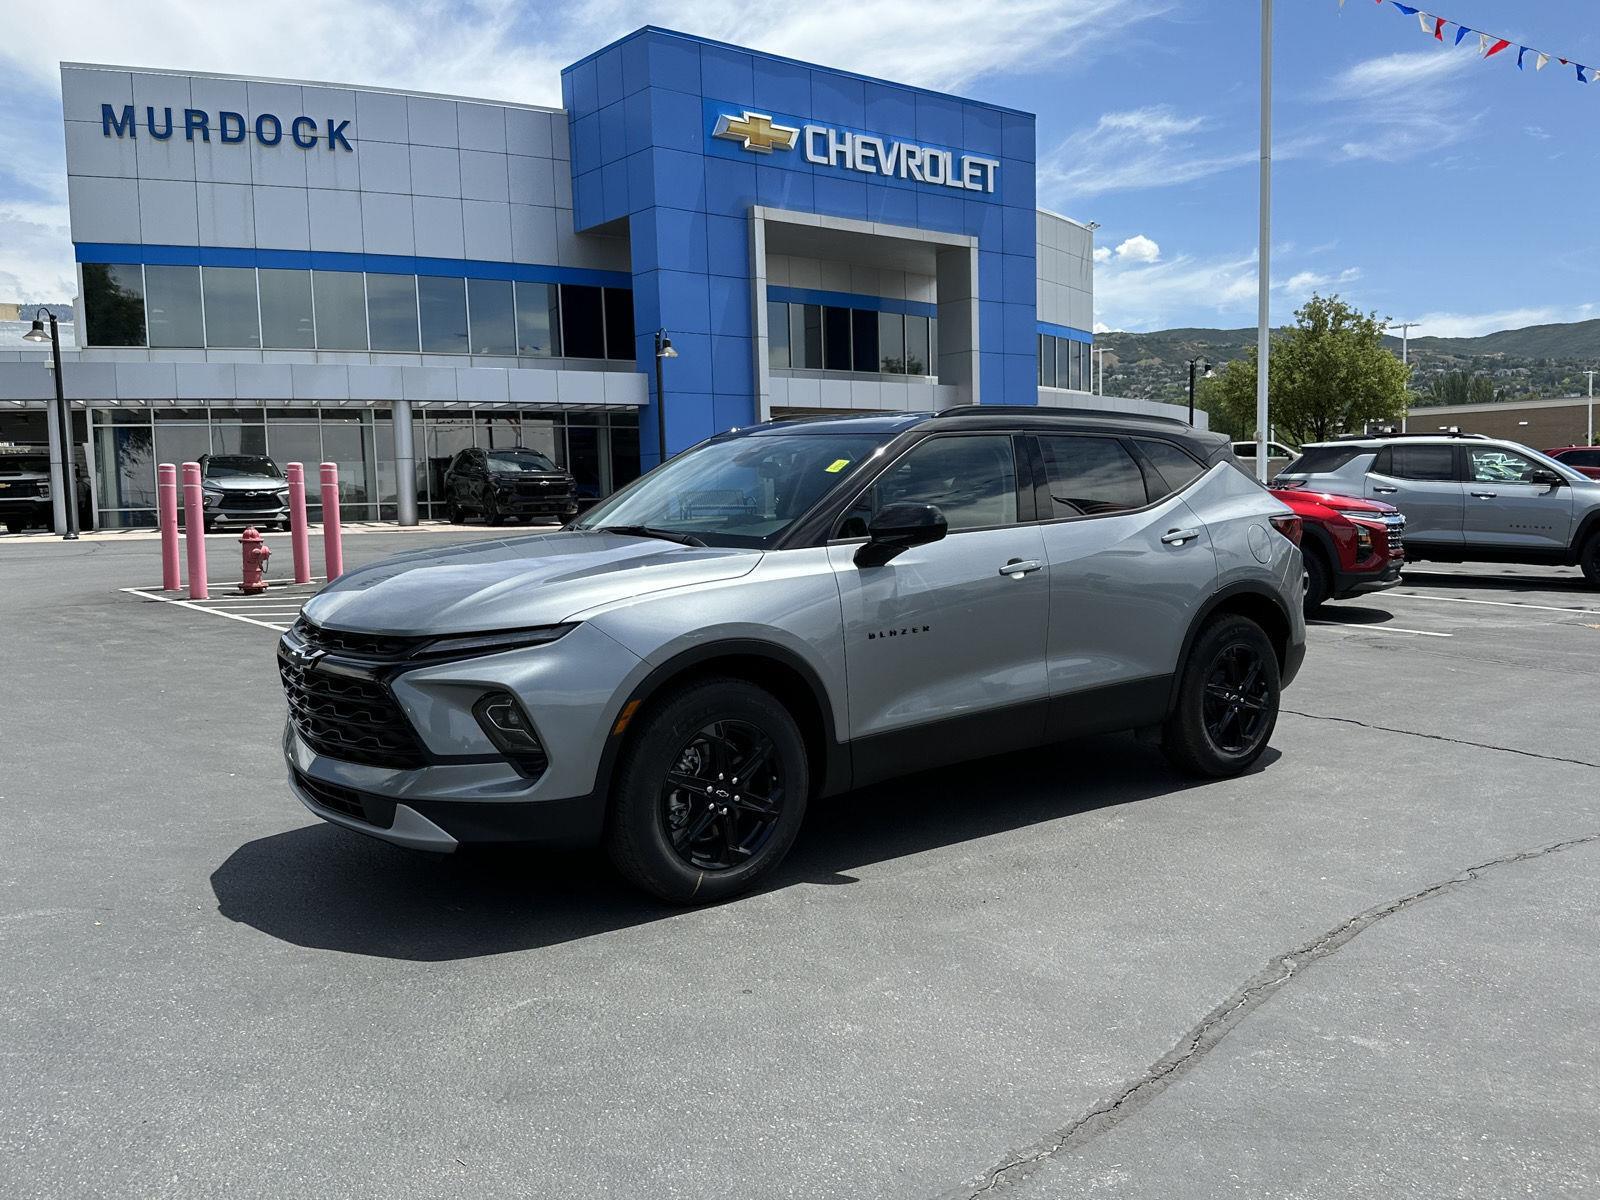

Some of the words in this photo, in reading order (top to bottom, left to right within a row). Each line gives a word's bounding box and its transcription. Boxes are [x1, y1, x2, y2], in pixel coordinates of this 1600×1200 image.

[101, 103, 353, 152] MURDOCK
[803, 124, 1000, 193] CHEVROLET
[868, 625, 930, 640] BLAZER
